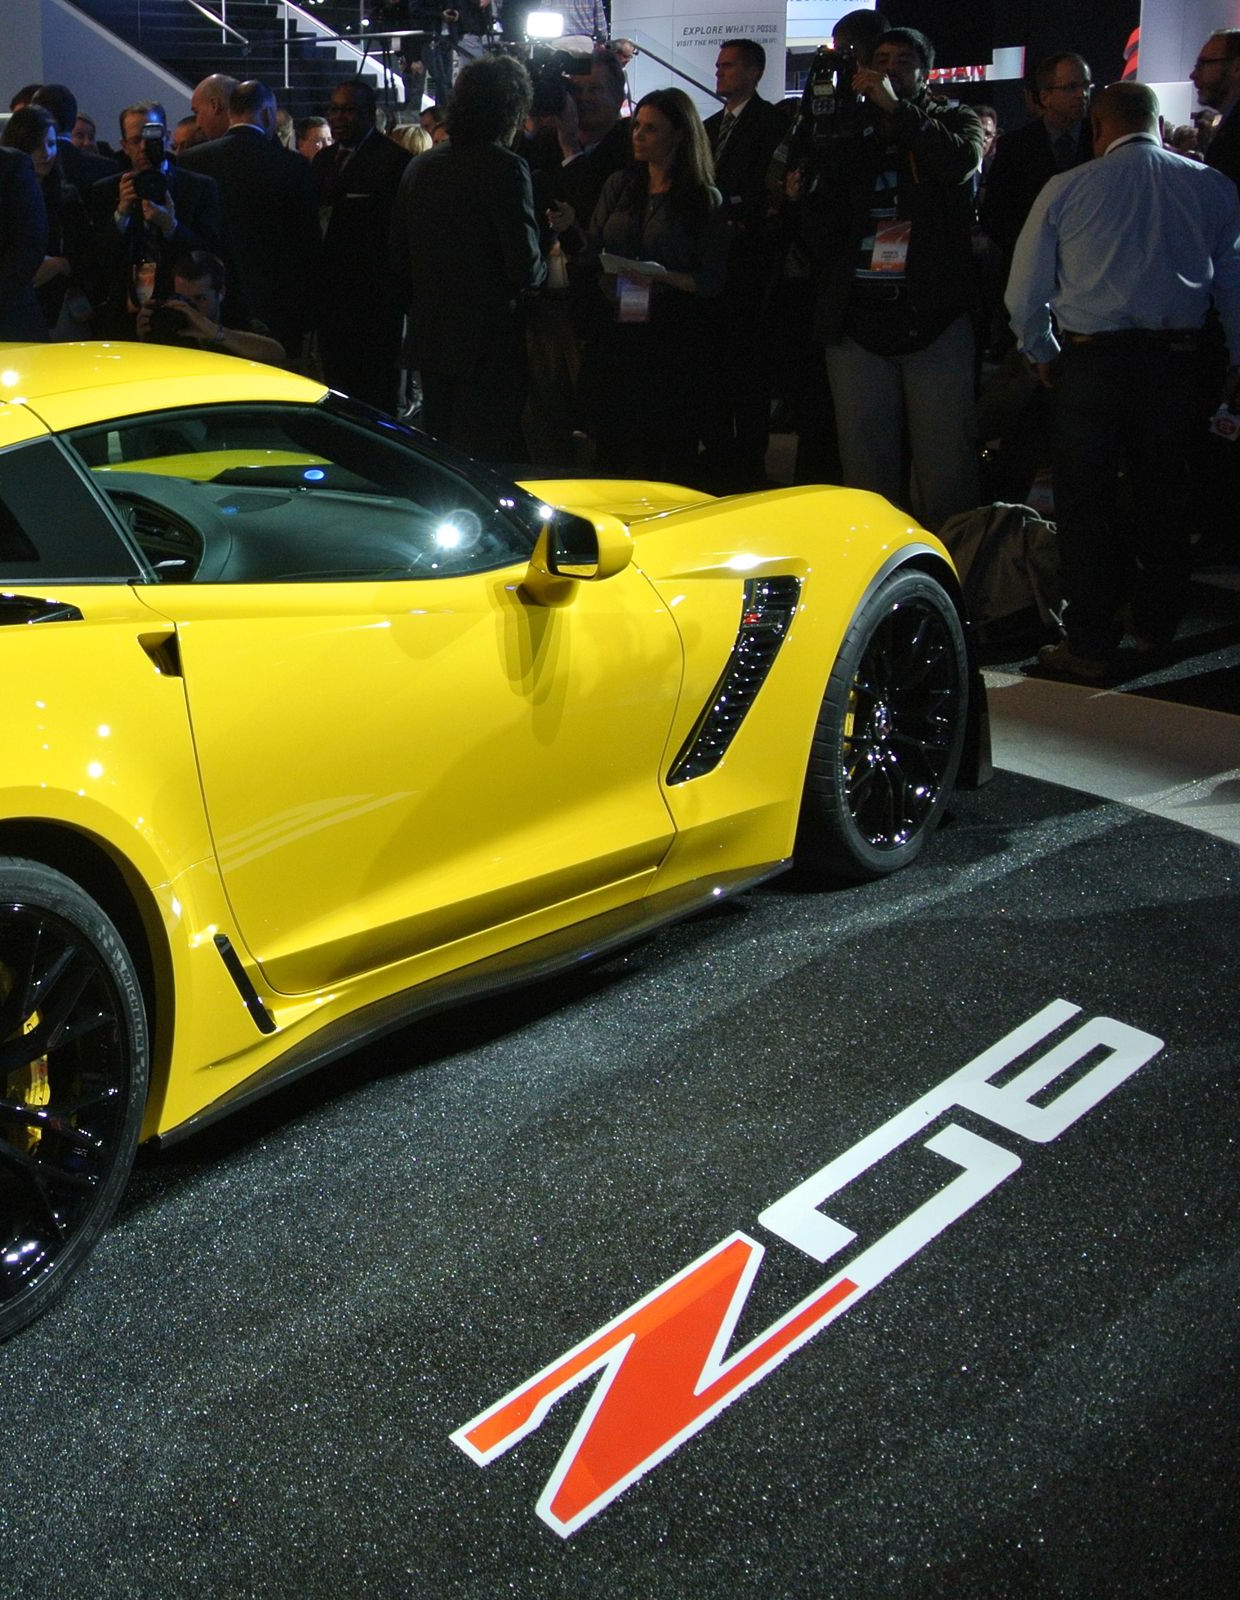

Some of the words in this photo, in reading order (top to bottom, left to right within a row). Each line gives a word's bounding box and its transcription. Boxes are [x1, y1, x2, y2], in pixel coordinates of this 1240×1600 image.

[683, 25, 723, 36] EXPLORE
[725, 25, 755, 34] WHAT'S
[449, 998, 1164, 1540] Z06
